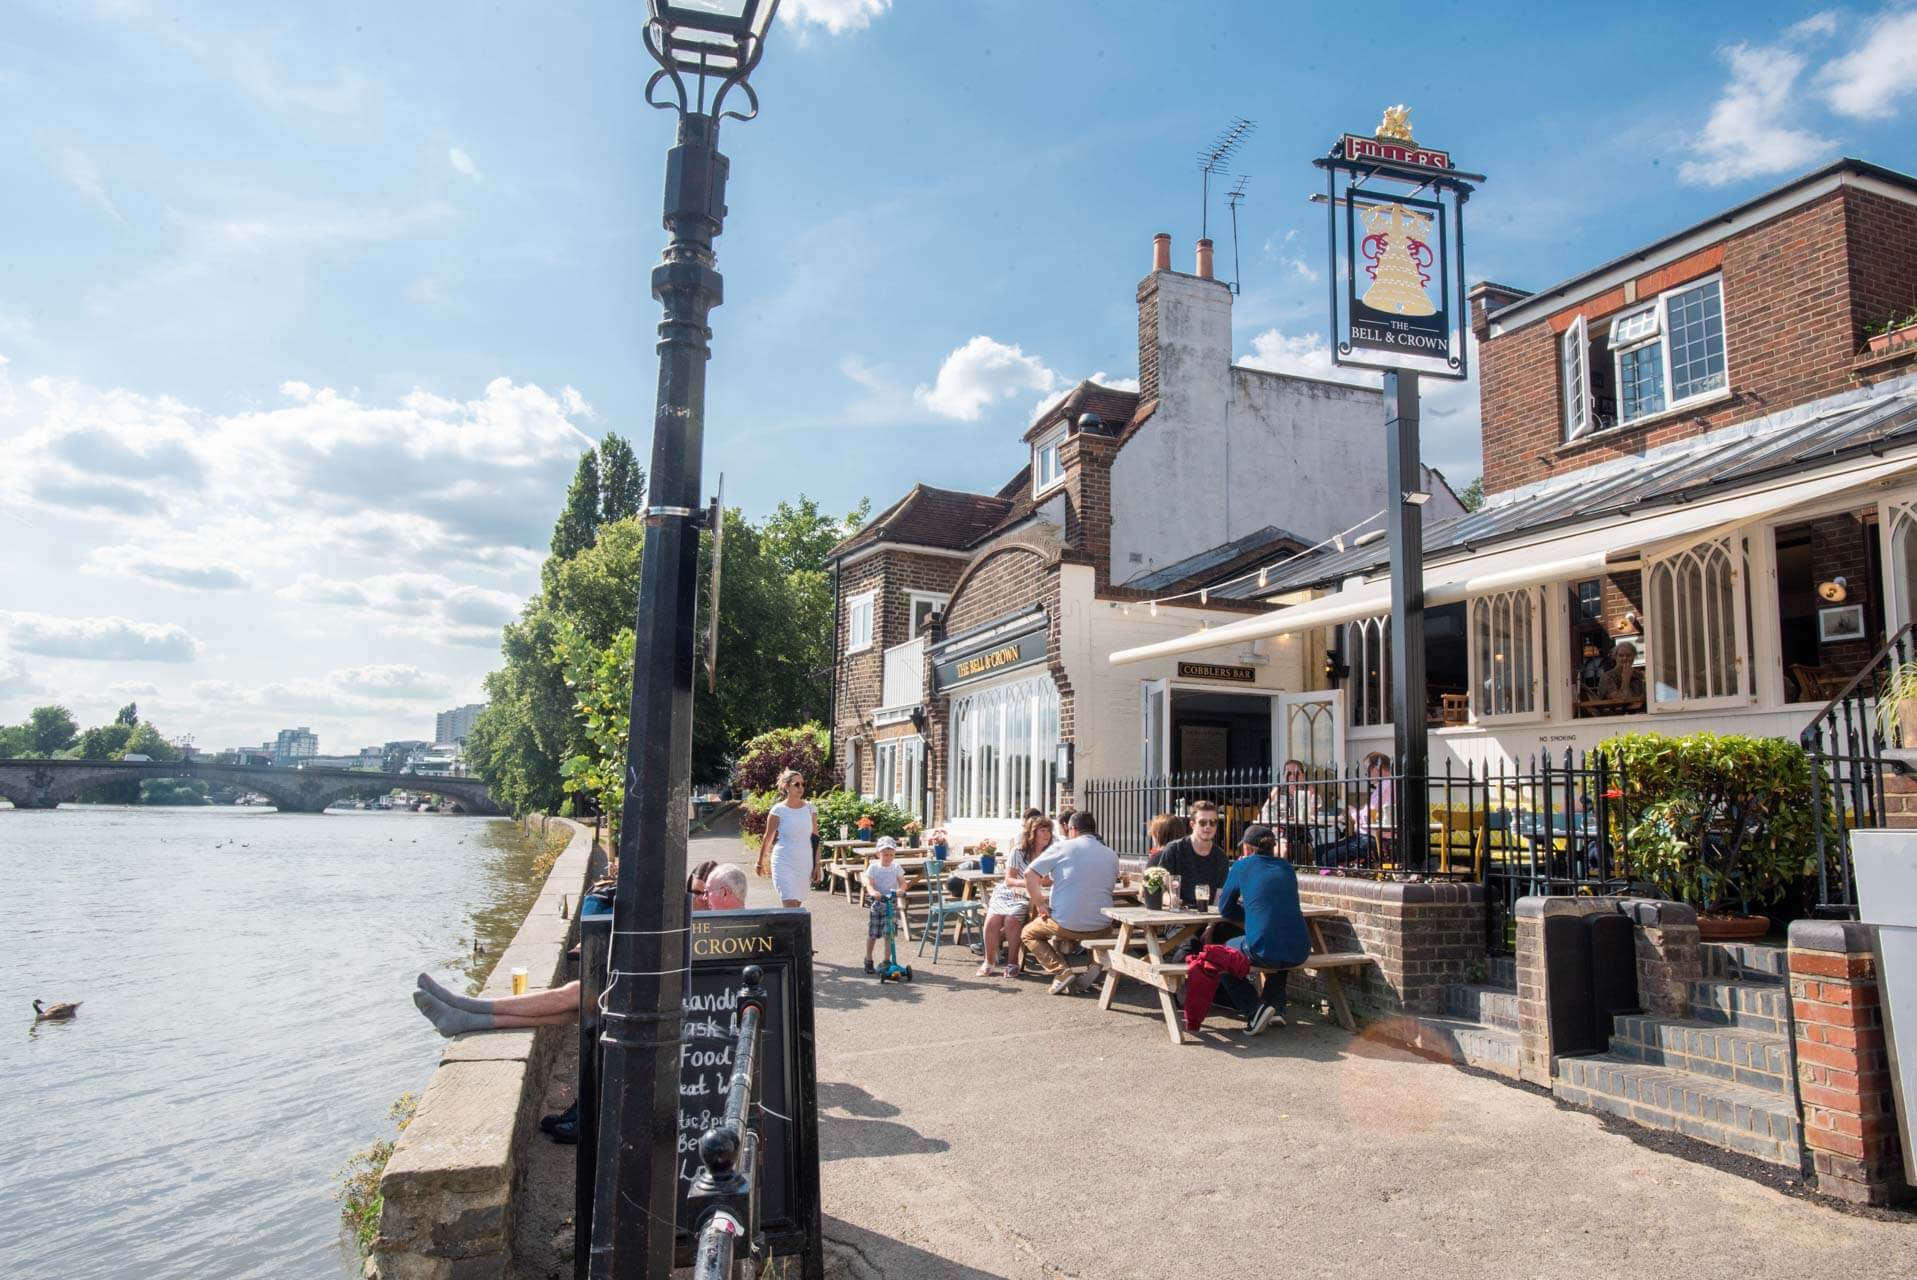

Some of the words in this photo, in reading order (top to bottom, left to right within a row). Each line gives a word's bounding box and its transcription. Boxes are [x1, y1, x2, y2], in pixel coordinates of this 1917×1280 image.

[1391, 320, 1409, 331] THE
[1351, 326, 1383, 342] BELL
[1385, 331, 1395, 344] &
[1397, 333, 1448, 351] CROWN
[956, 661, 970, 678] THE
[970, 657, 985, 673] BELL
[985, 655, 991, 670] &
[991, 644, 1019, 668] CROWN
[1183, 665, 1231, 677] COBBLERS
[1233, 669, 1251, 679] BAR
[1550, 734, 1576, 742] SMOKING
[692, 922, 711, 934] HE
[694, 936, 774, 956] CROWN
[684, 1015, 720, 1038] ask
[680, 1043, 732, 1068] Food
[680, 1073, 711, 1096] eat
